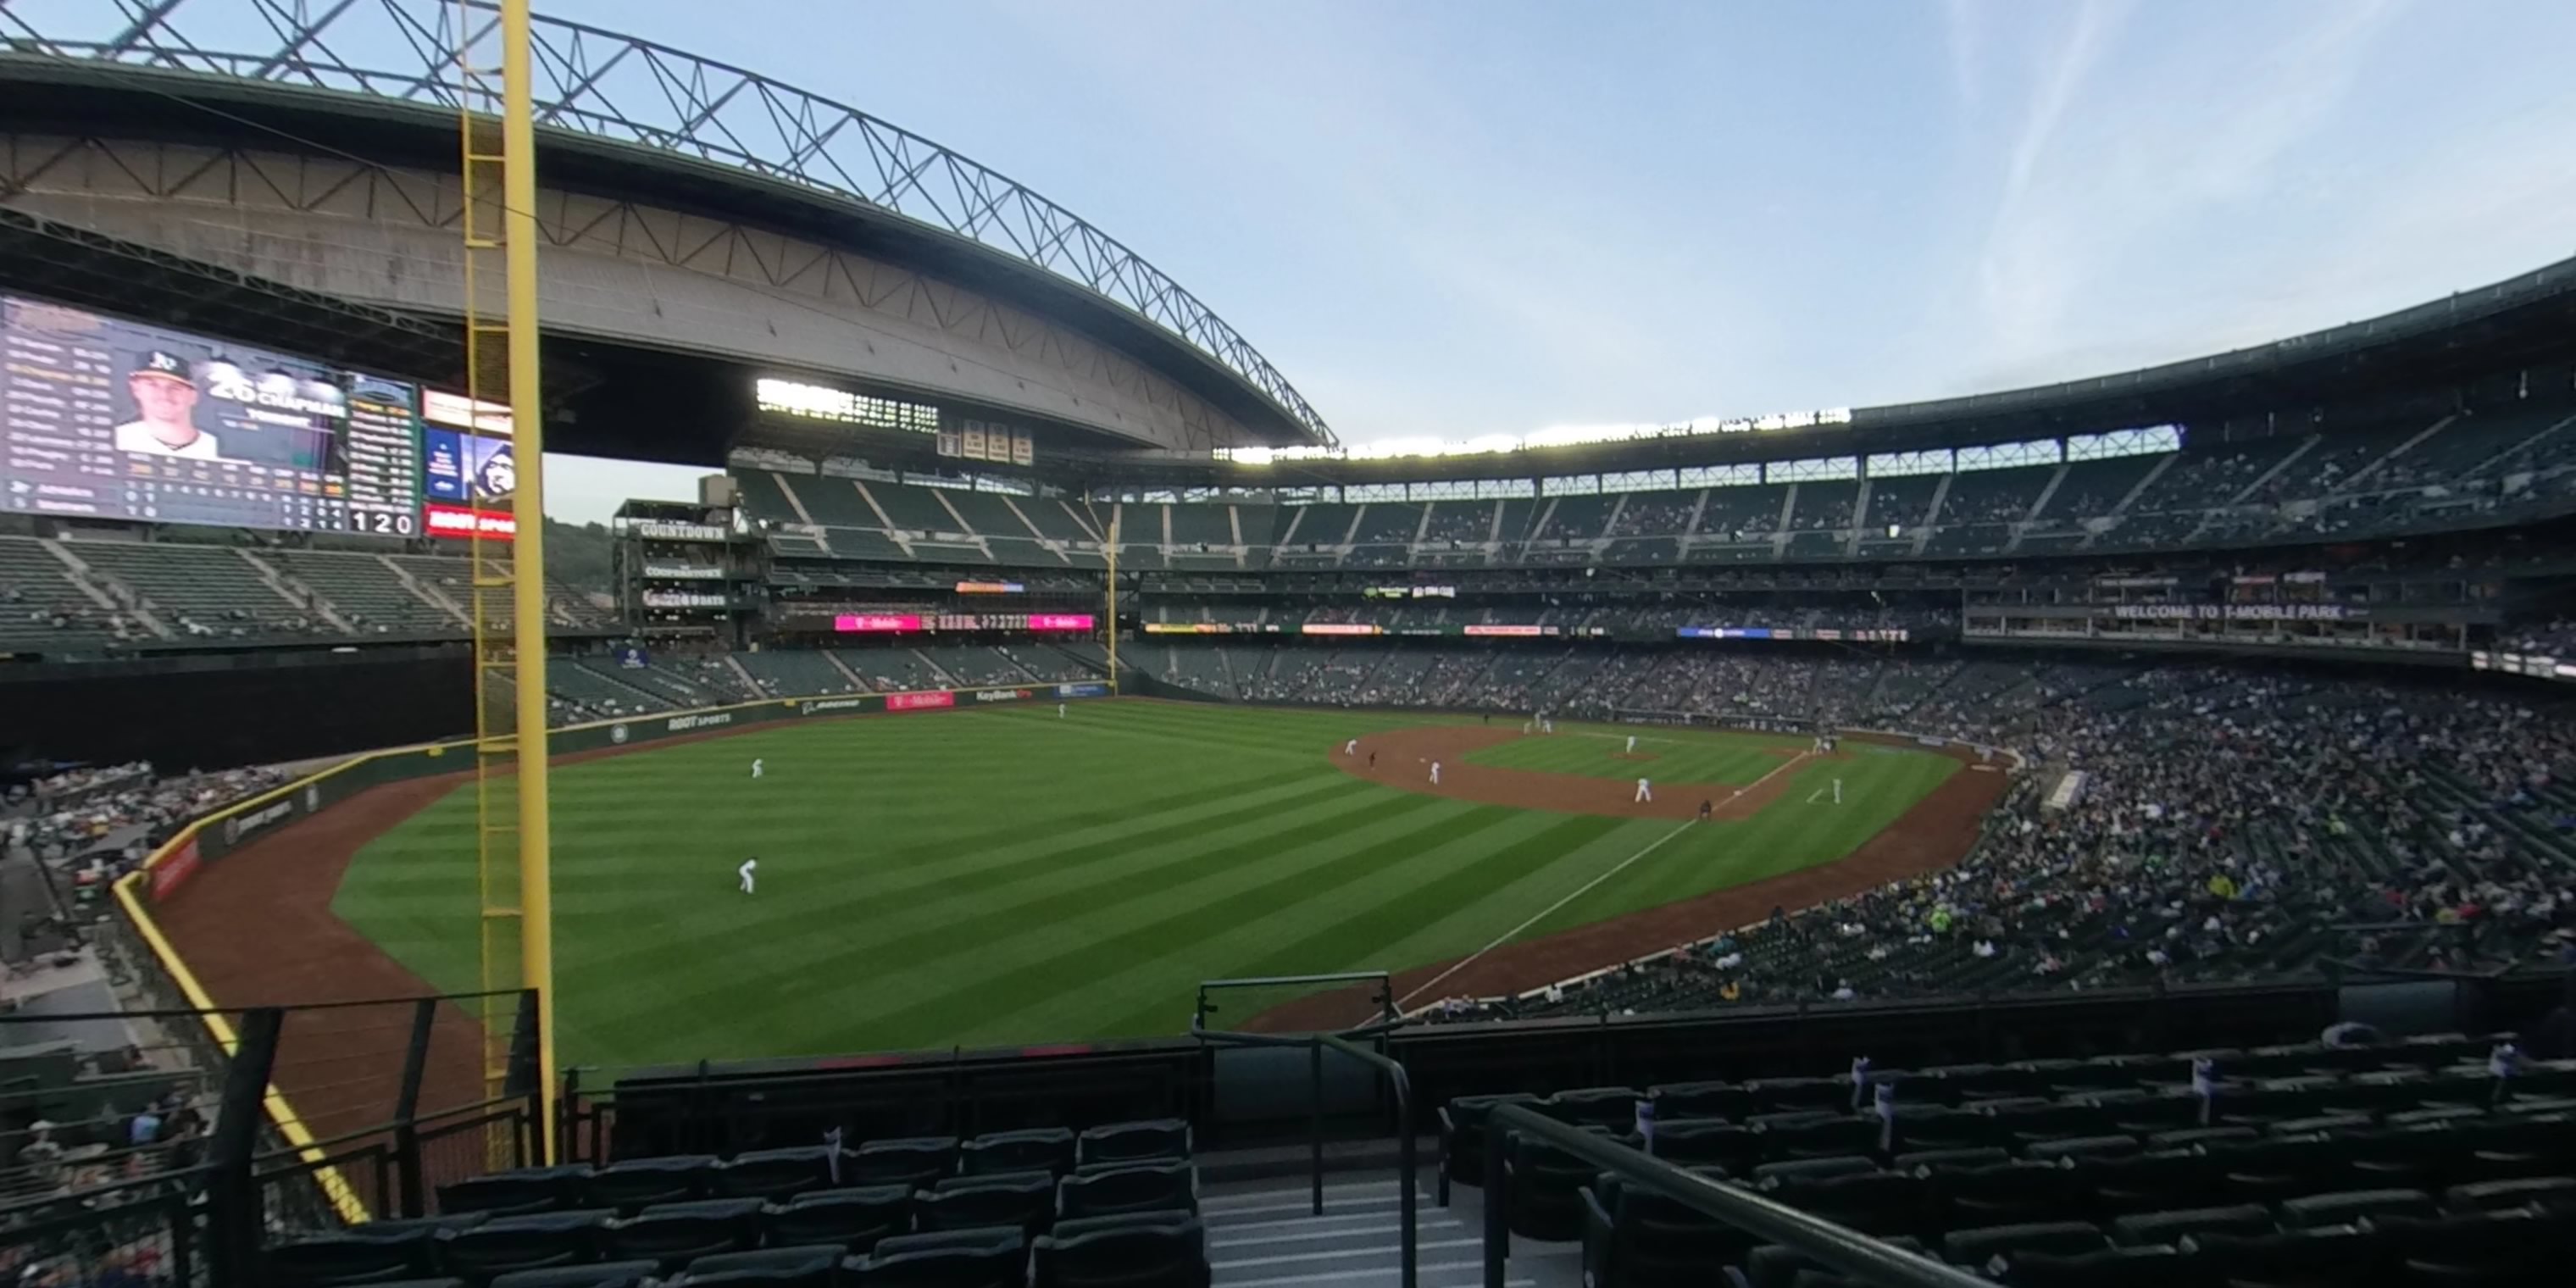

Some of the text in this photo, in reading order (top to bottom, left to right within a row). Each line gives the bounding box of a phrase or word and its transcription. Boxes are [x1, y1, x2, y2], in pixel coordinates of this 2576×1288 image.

[258, 392, 346, 418] CHAPMAN
[353, 512, 411, 534] 1 2 0
[641, 524, 724, 540] COUNTDOWN
[2115, 604, 2342, 619] WELCOME TO T-MOBILE PARK
[976, 690, 1017, 702] KeyBank
[668, 715, 697, 730] ROOT
